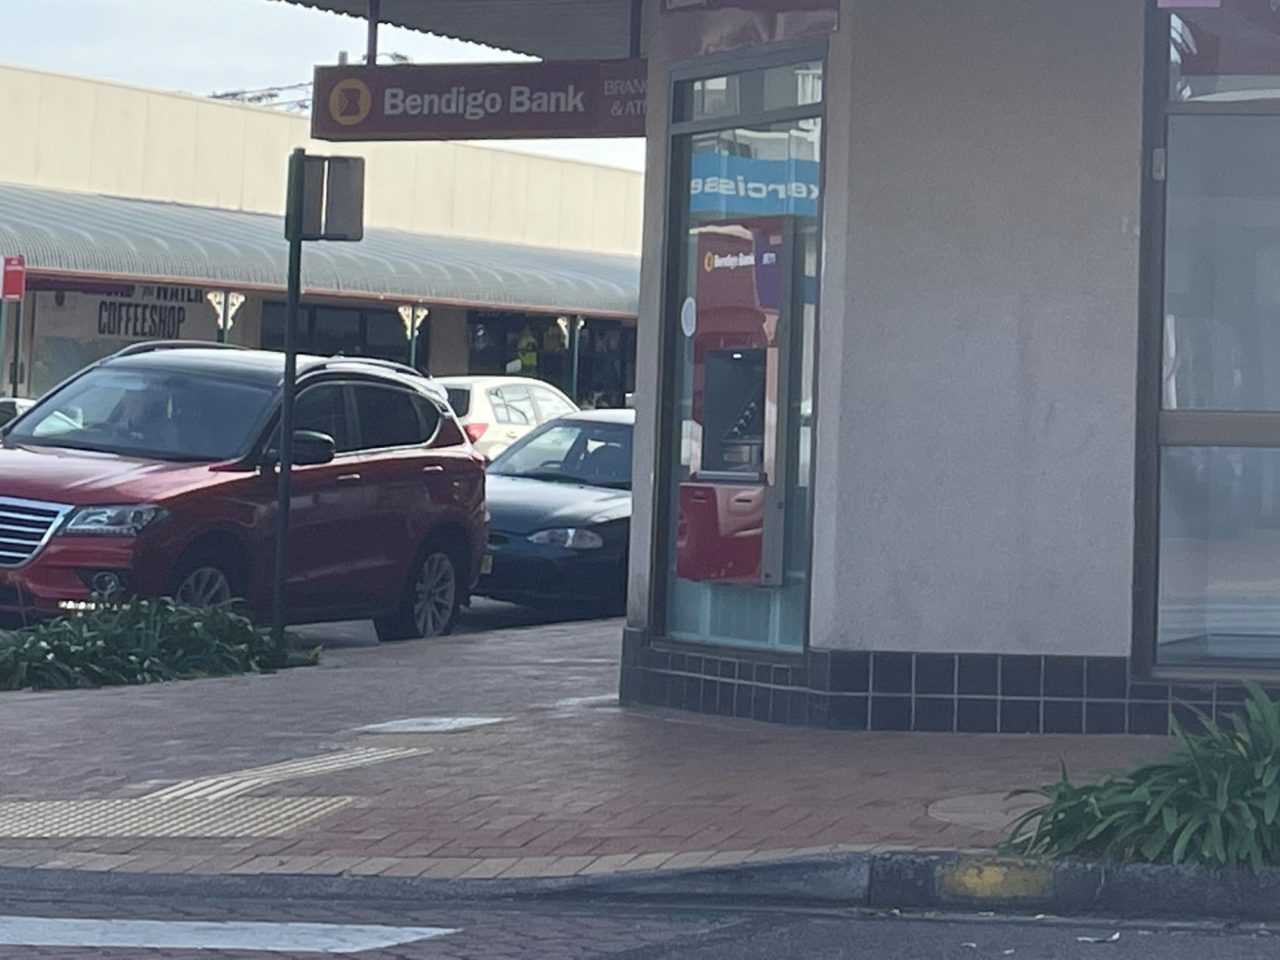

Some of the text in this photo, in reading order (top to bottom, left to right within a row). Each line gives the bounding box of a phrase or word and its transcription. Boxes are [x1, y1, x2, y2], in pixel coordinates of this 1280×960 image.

[383, 84, 585, 120] Bendigo Bank
[610, 103, 623, 117] &
[97, 301, 186, 339] COFFEESHOP
